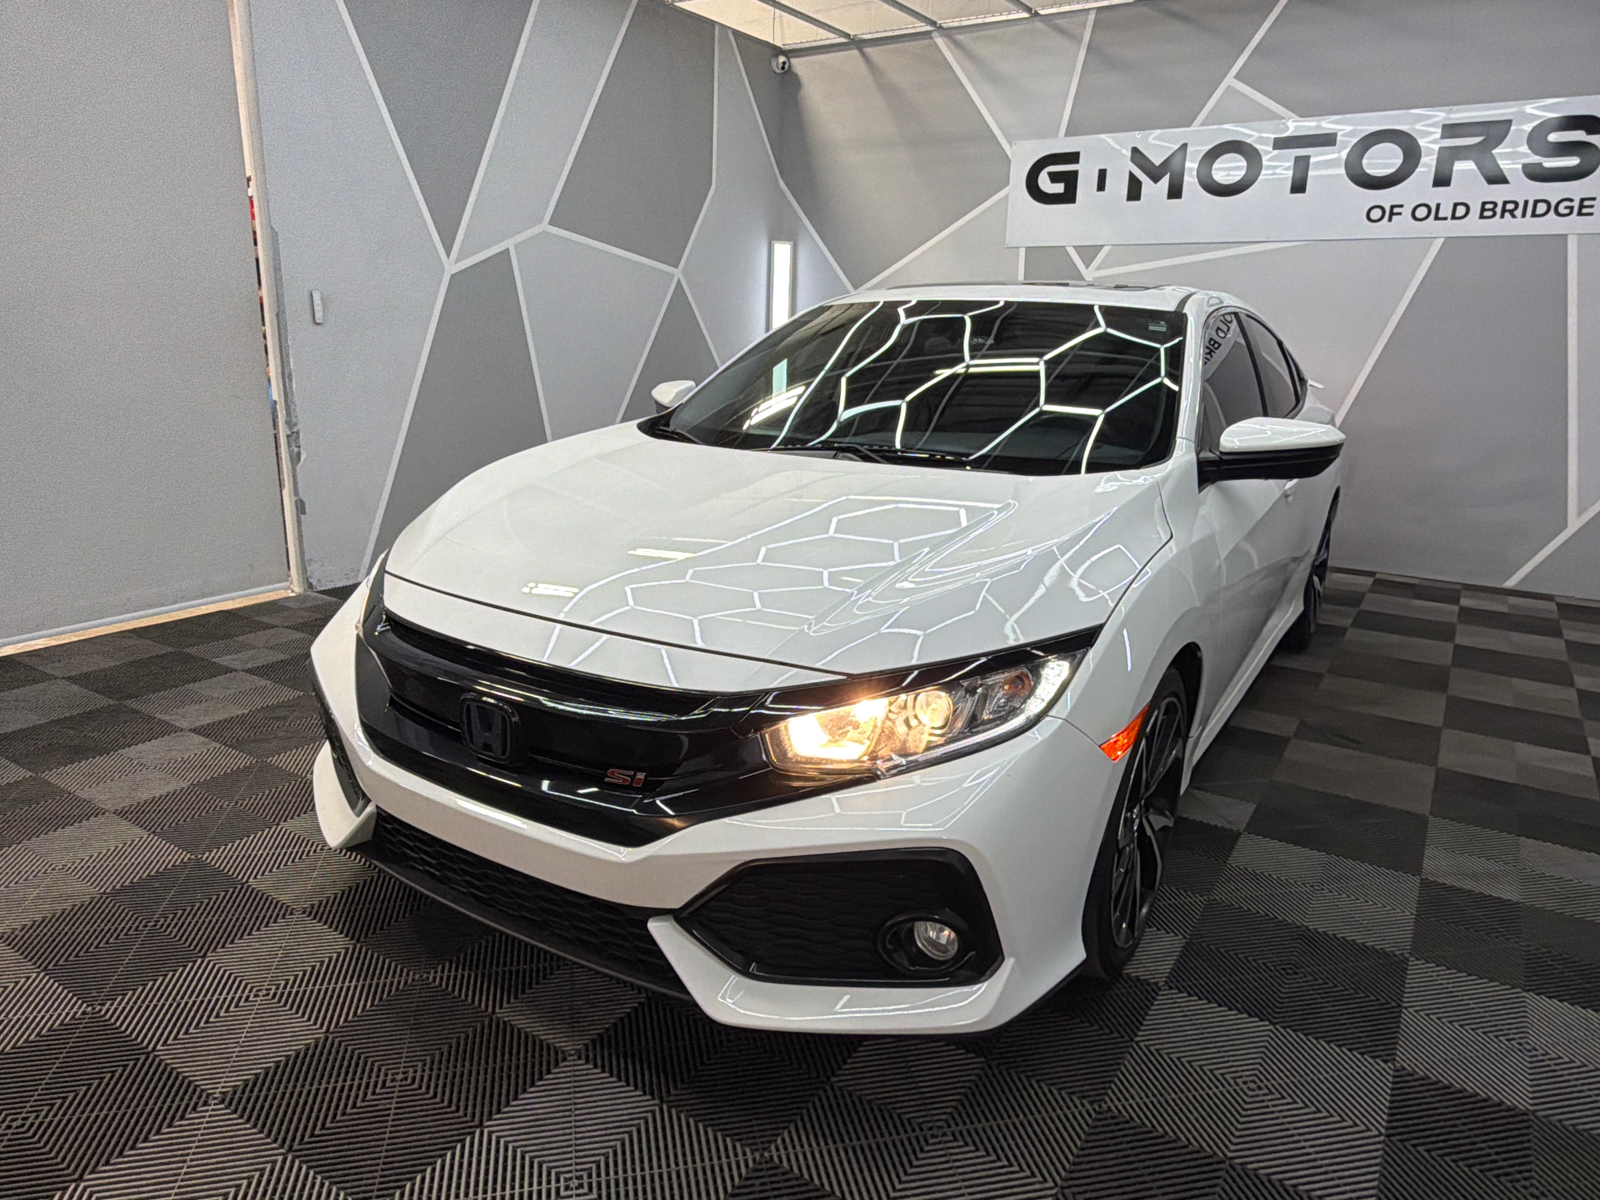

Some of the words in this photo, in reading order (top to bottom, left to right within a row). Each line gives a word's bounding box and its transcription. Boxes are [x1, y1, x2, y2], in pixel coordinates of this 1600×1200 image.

[1365, 203, 1404, 224] OF
[1410, 201, 1471, 222] OLD
[1478, 196, 1597, 220] BRIDGE
[604, 768, 646, 788] Si
